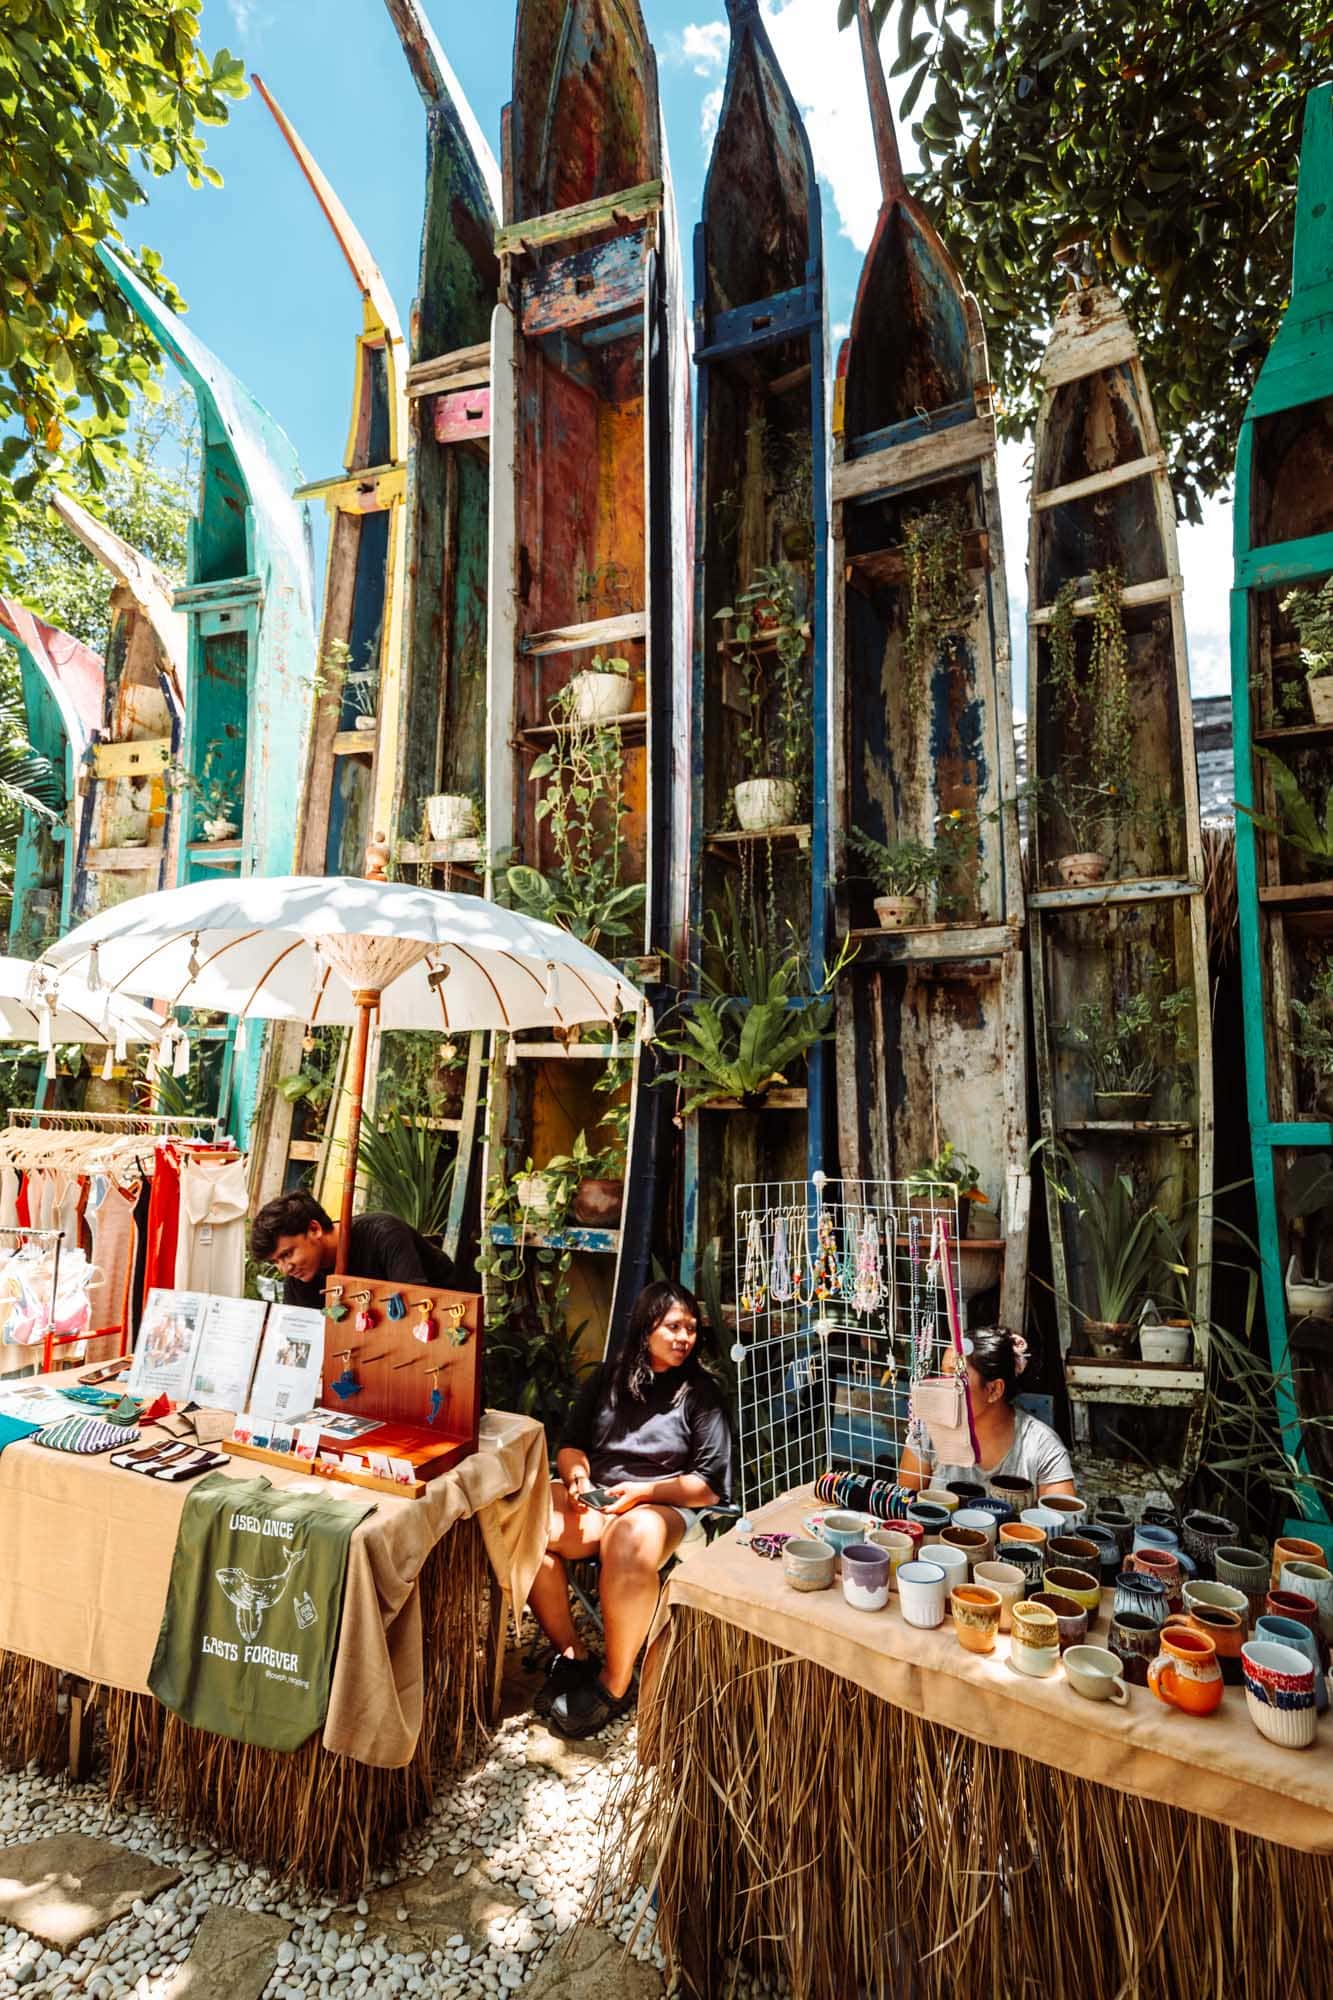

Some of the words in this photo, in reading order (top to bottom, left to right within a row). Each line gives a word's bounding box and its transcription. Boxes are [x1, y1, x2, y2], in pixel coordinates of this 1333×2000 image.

[229, 1514, 260, 1533] USED
[262, 1519, 294, 1540] ONCE
[202, 1636, 238, 1662] LASTS
[243, 1646, 298, 1673] FOREVER
